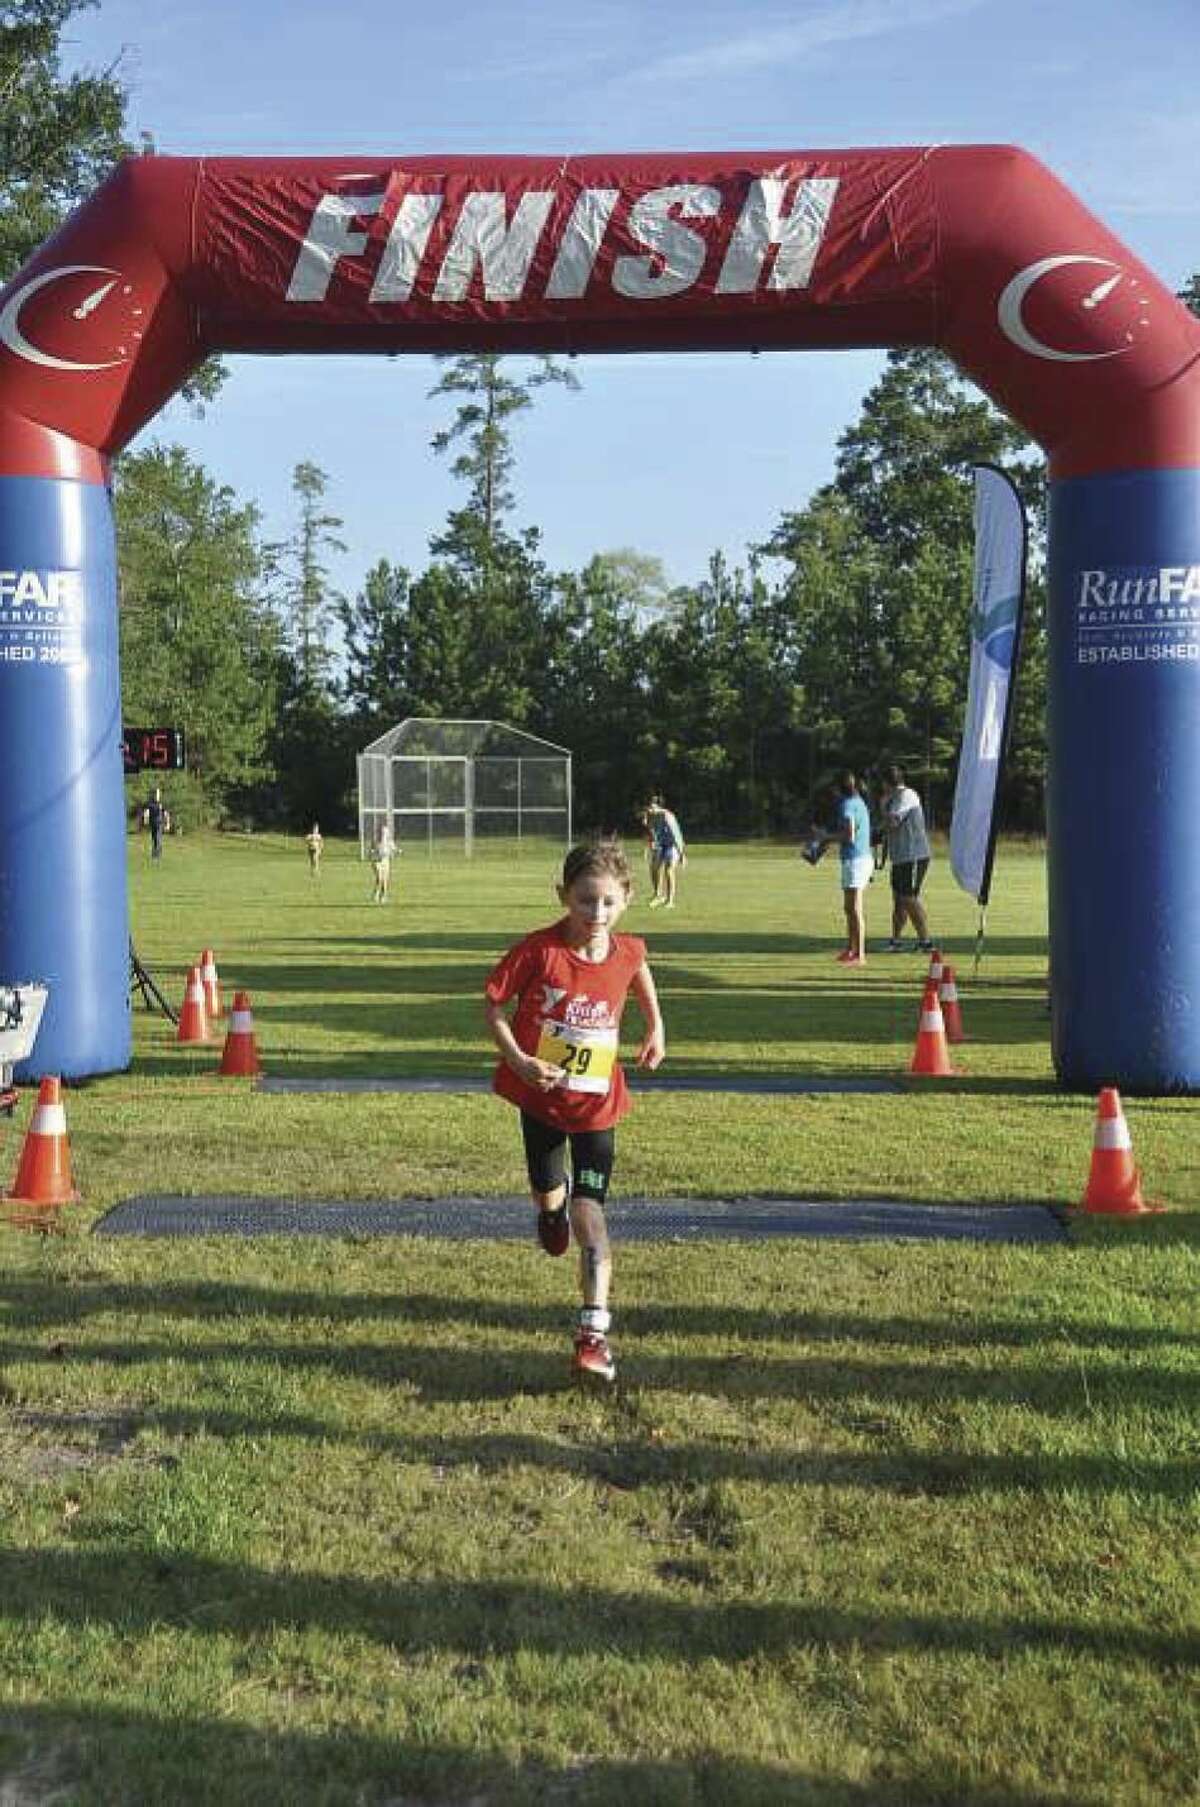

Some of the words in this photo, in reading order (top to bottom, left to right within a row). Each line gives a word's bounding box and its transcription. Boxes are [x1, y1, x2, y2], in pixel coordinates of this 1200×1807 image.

[284, 178, 840, 301] FINISH
[1078, 644, 1199, 663] ESTABLISHED
[560, 1044, 592, 1075] 29
